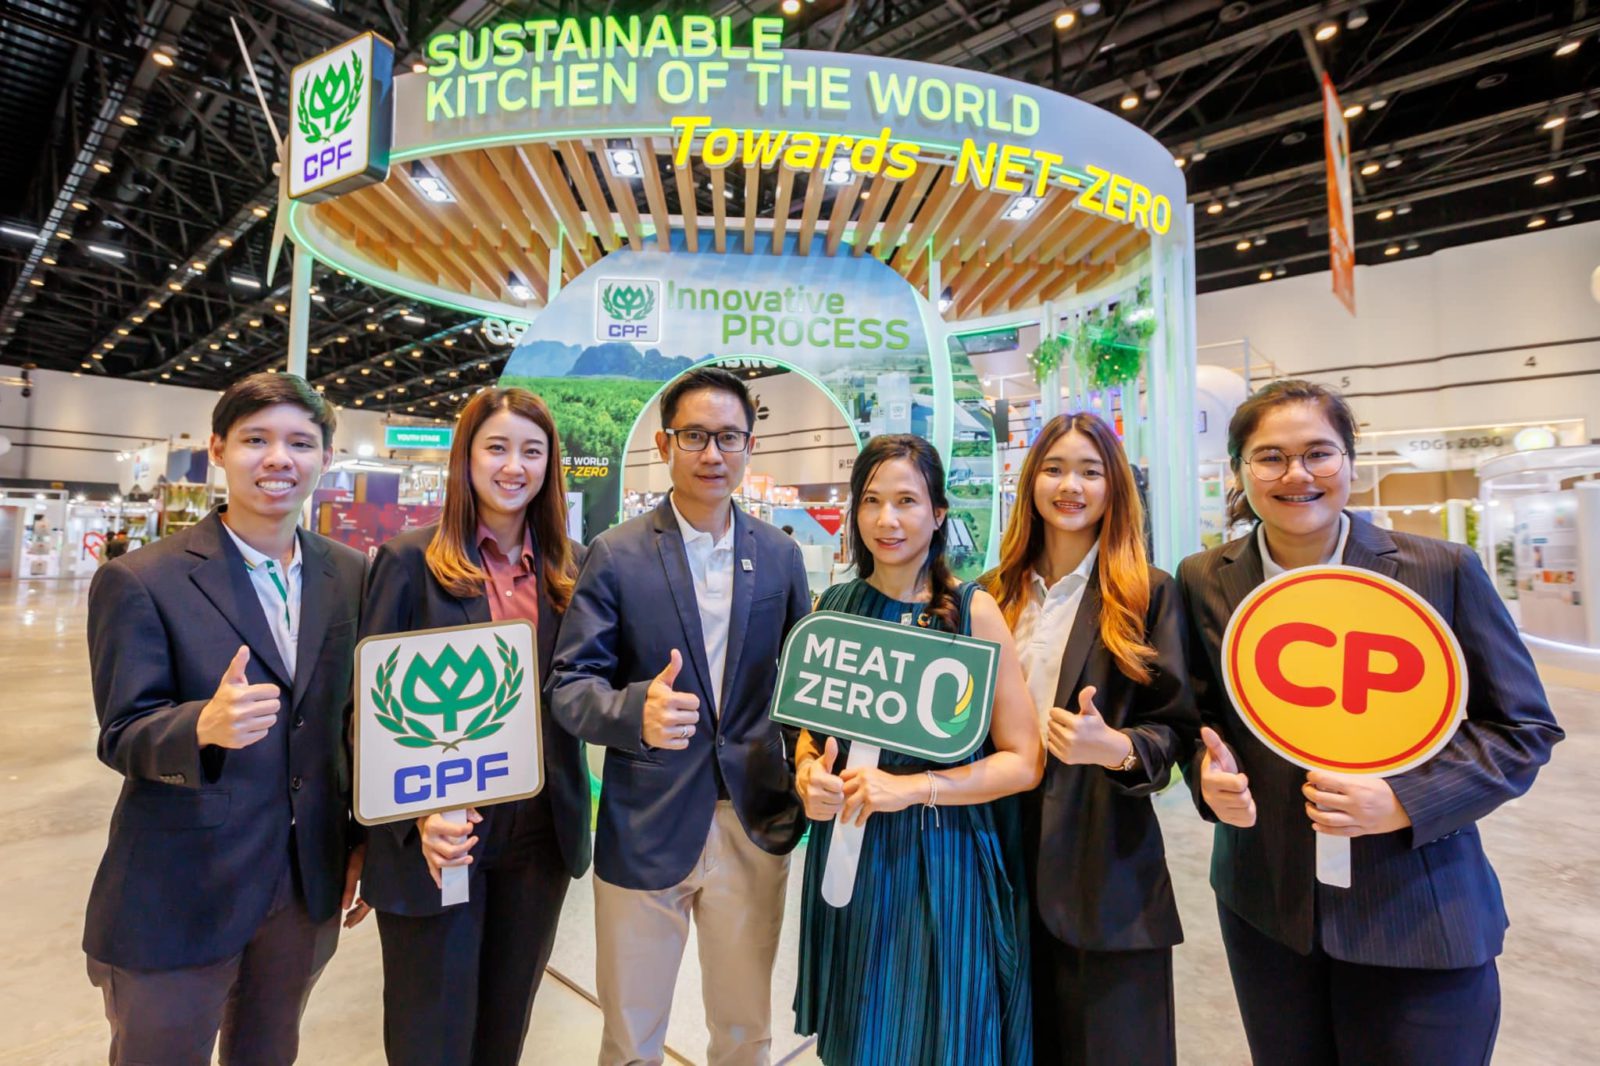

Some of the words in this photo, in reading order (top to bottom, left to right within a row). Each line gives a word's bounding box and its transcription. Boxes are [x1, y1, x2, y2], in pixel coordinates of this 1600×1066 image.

[427, 14, 784, 77] SUSTAINABLE
[426, 61, 637, 122] KITCHEN
[657, 60, 729, 104] OF
[746, 63, 851, 110] THE
[868, 71, 1040, 136] WORLD
[303, 139, 353, 183] CPF
[671, 116, 921, 180] Towards
[952, 137, 1172, 236] NET-ZERO
[667, 279, 846, 314] Innovative
[608, 324, 648, 338] CPF
[721, 313, 910, 350] PROCESS
[1341, 376, 1351, 388] 5
[573, 456, 609, 466] WORLD
[803, 633, 916, 684] MEAT
[1254, 622, 1426, 715] CP
[793, 670, 908, 725] ZERO
[393, 751, 510, 805] CPF
